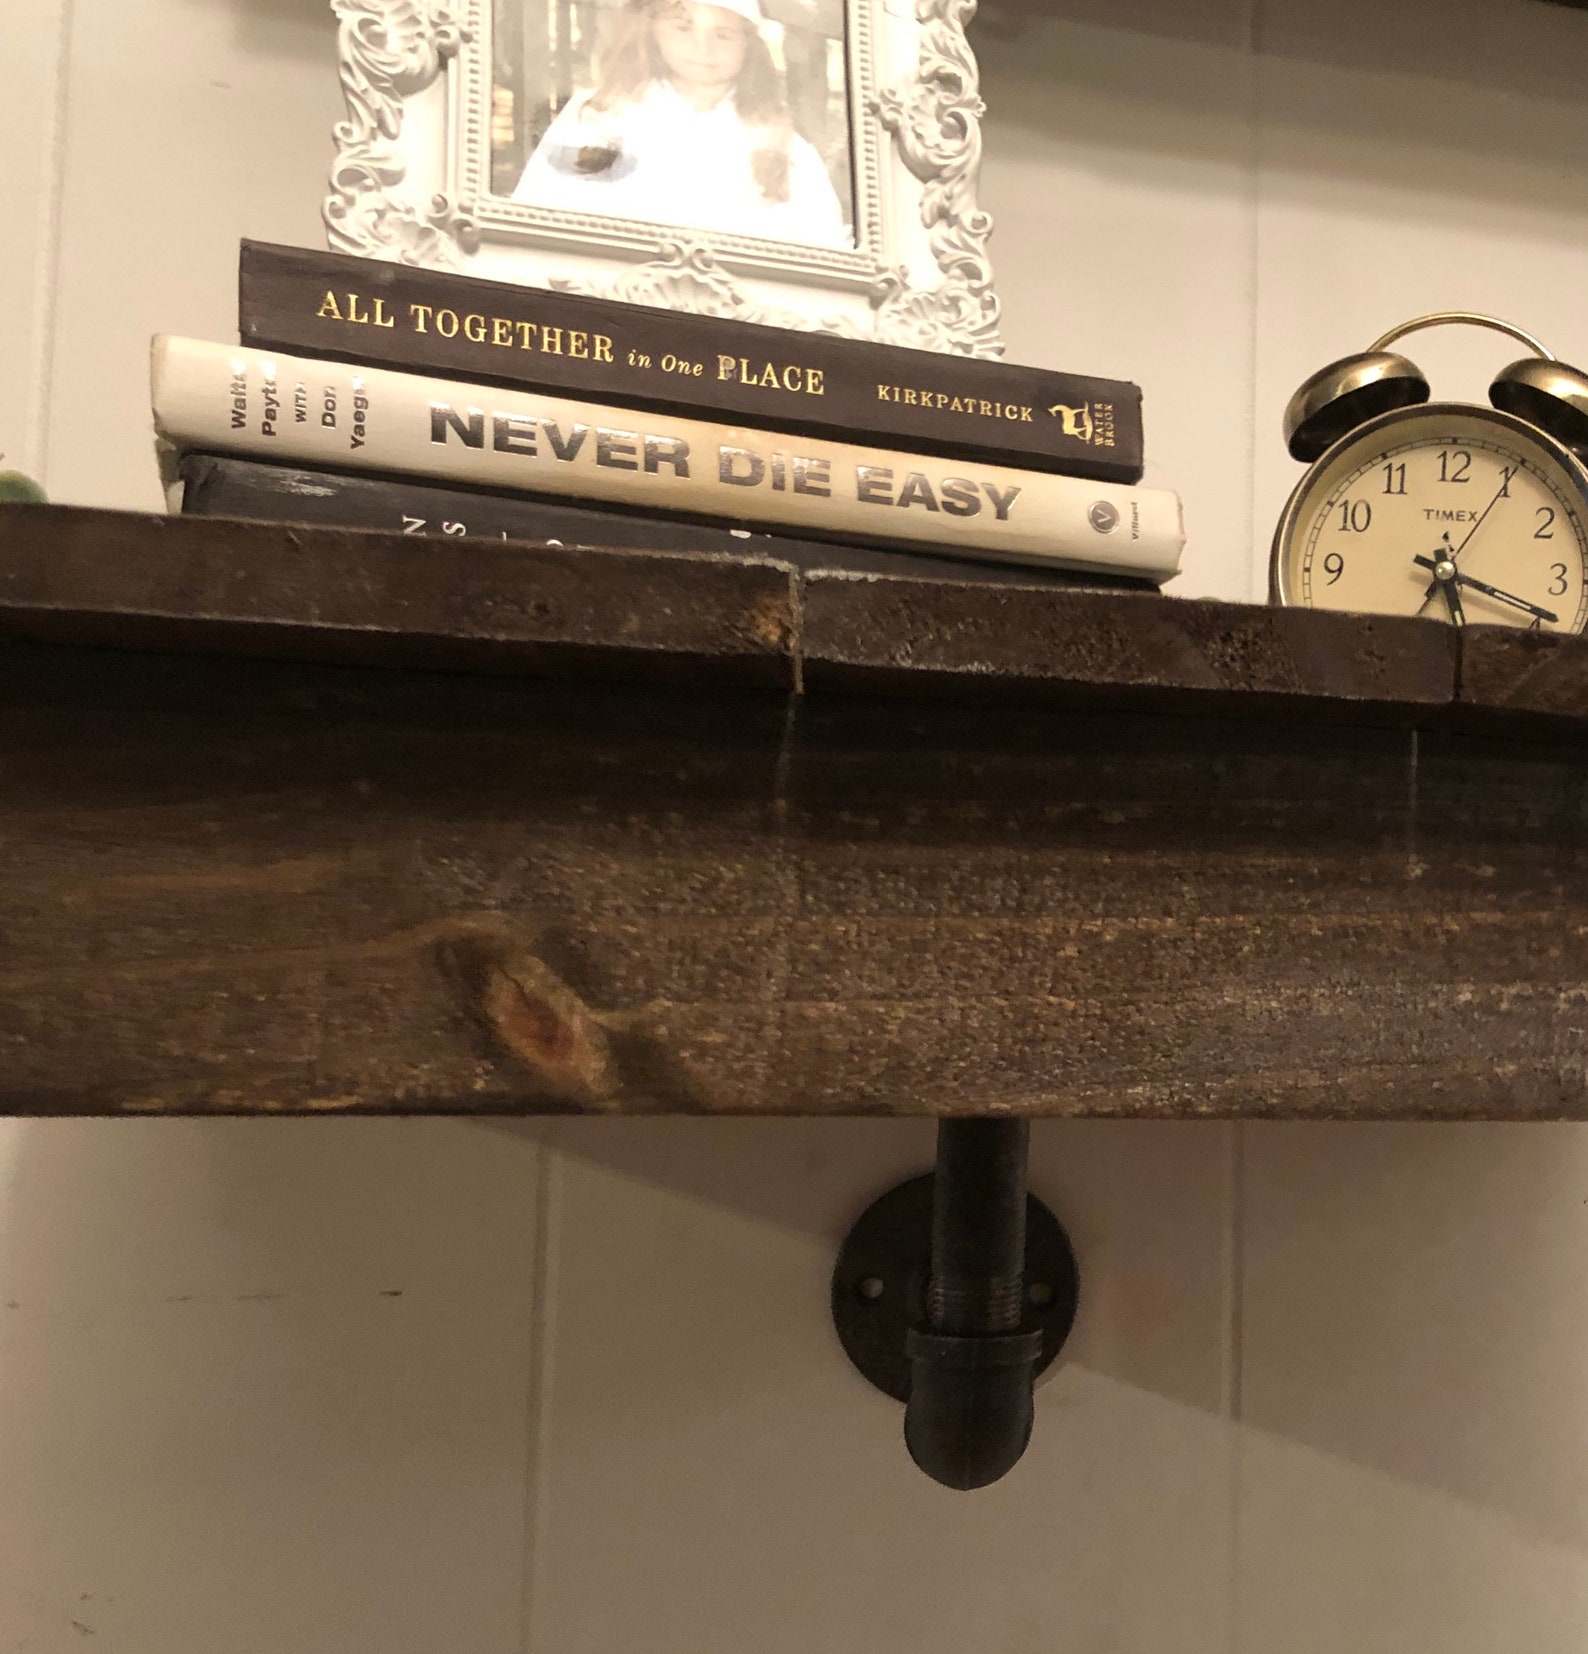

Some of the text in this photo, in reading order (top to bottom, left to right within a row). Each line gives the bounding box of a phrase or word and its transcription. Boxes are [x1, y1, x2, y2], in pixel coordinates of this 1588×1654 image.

[317, 290, 825, 396] ALL TOGETHER in One PLACE
[229, 359, 247, 429] Walt
[260, 361, 280, 437] Payt
[876, 384, 1034, 423] KIRKPATRICK
[350, 376, 369, 449] Yaeg
[1094, 402, 1103, 446] WATER
[1103, 403, 1115, 447] BROOK
[430, 401, 1022, 521] NEVER DIE EASY
[1382, 462, 1409, 495] 11
[1437, 450, 1472, 484] 12
[1498, 466, 1512, 498] 1
[1337, 499, 1372, 533] 10
[1423, 508, 1479, 523] TIMEX
[1533, 506, 1556, 540] 2
[1323, 552, 1345, 586] 9
[1548, 562, 1569, 596] 3
